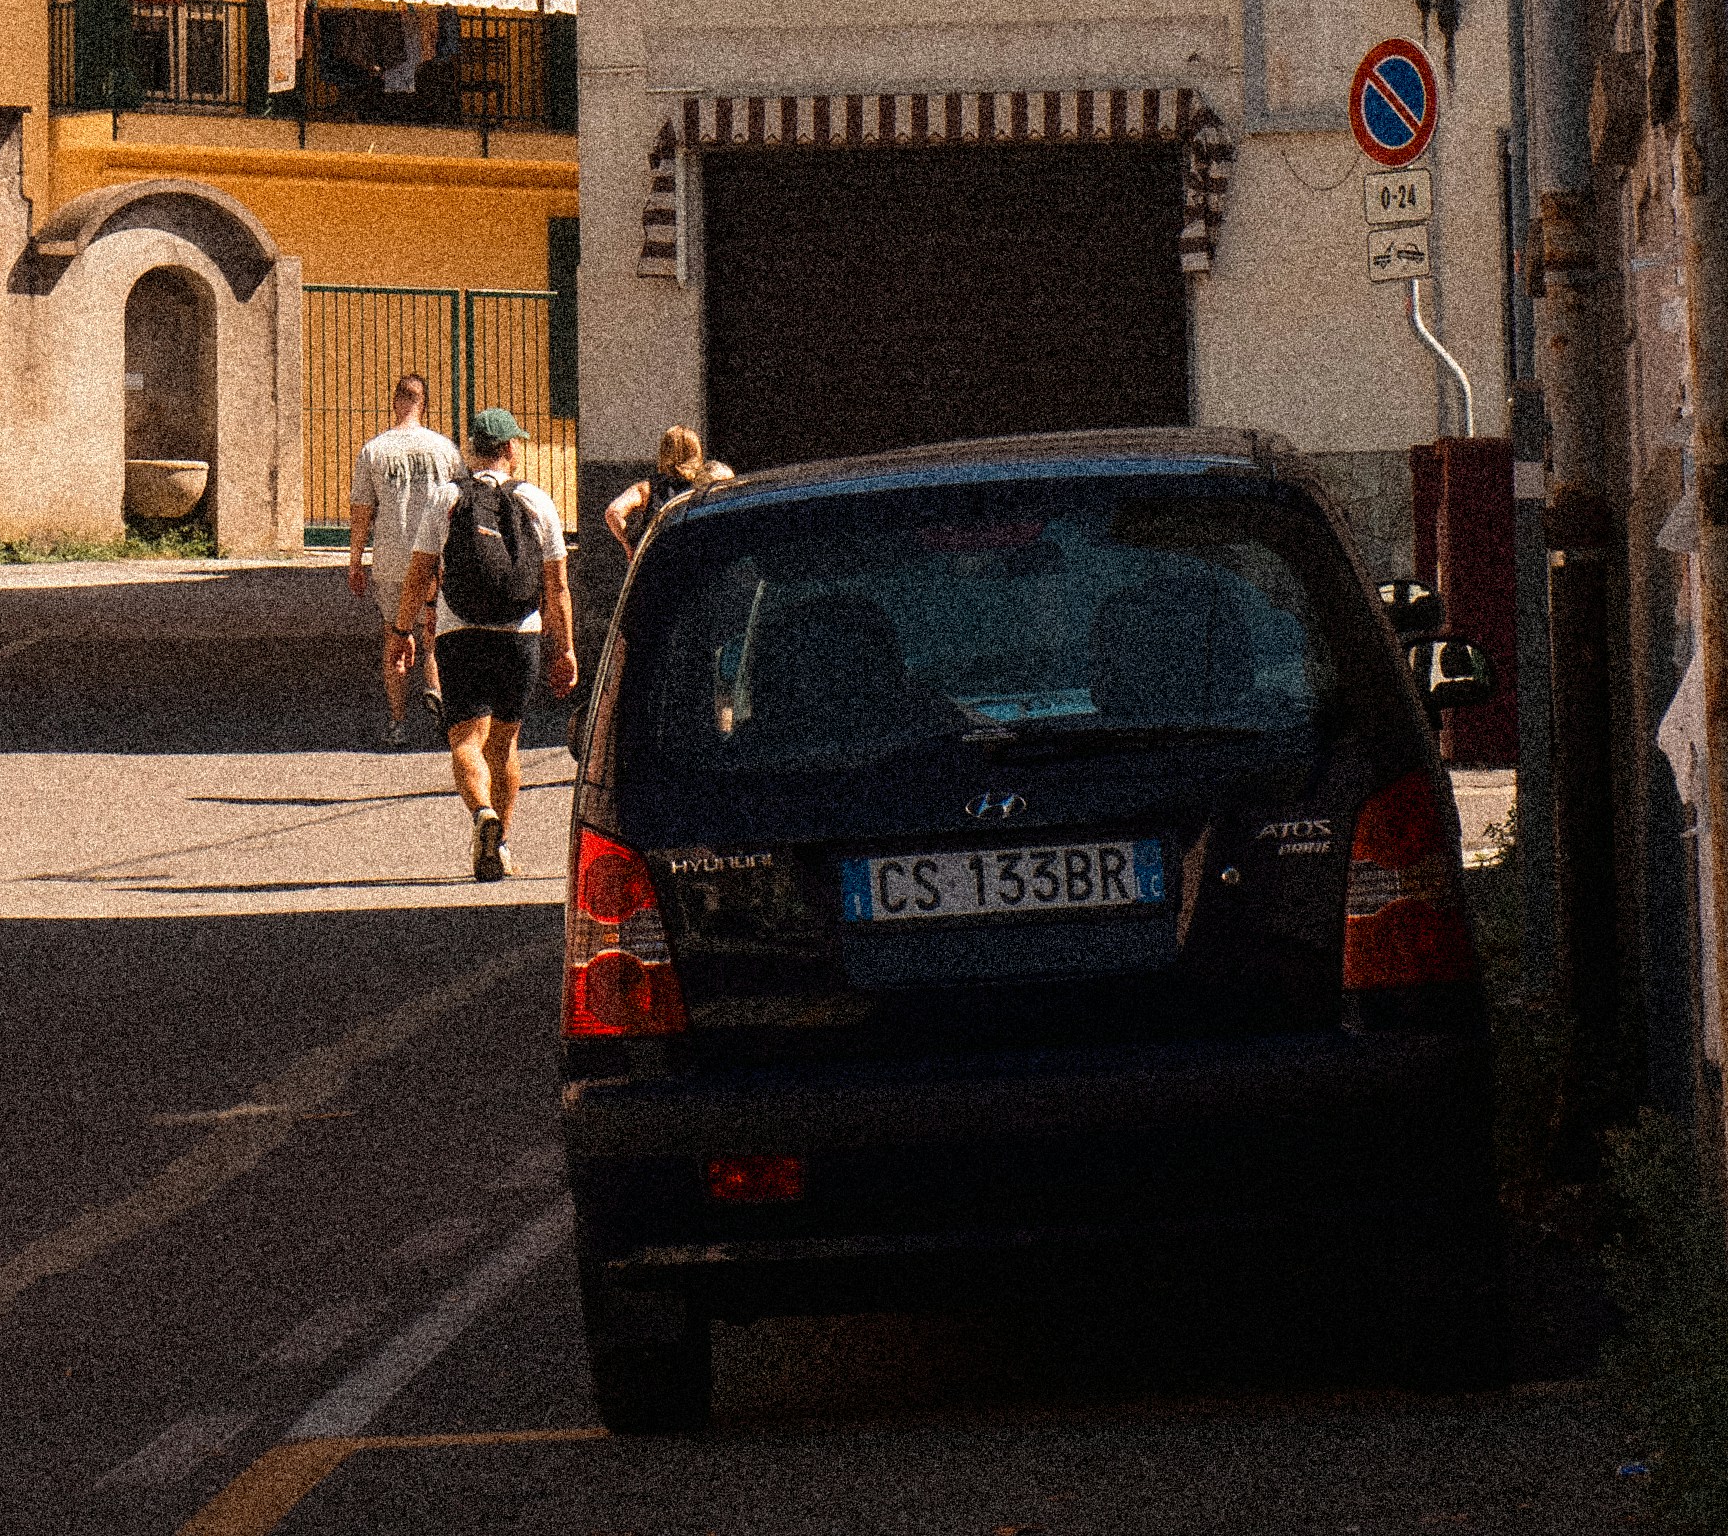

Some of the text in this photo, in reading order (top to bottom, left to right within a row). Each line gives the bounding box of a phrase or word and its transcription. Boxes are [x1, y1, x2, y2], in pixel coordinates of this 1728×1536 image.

[1382, 185, 1416, 210] 0-24
[1255, 818, 1333, 840] ATOS
[879, 860, 942, 914] CS
[969, 847, 1129, 907] 133BR
